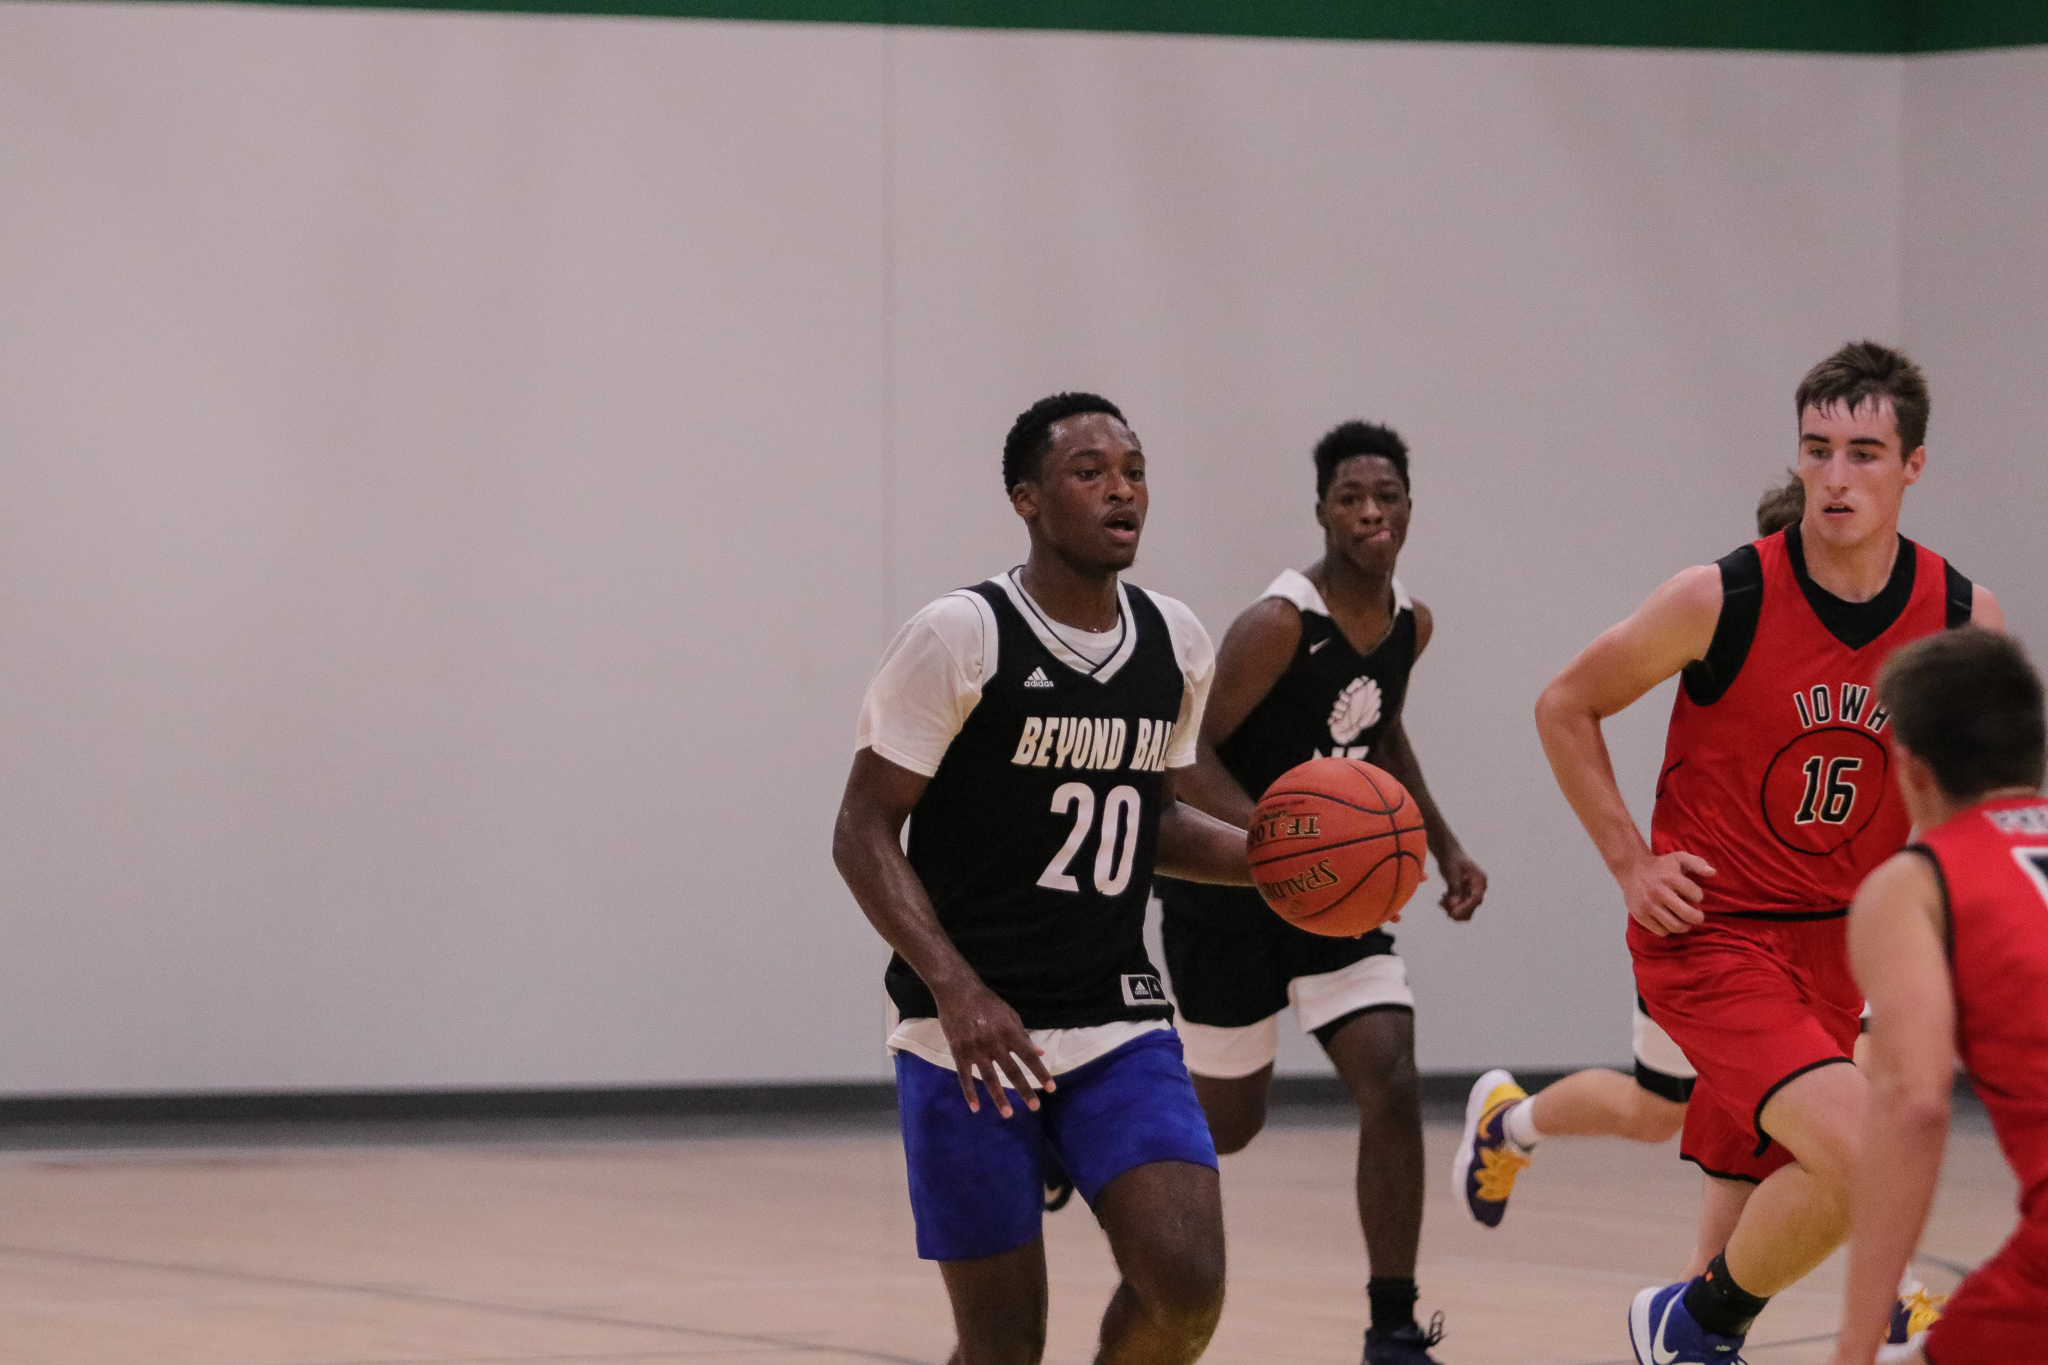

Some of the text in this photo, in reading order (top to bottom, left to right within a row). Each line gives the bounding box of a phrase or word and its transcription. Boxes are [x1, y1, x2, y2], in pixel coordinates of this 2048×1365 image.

[1024, 678, 1054, 688] adidas
[1793, 682, 1891, 734] IOWA
[1011, 716, 1127, 770] BEYOND
[1794, 755, 1863, 825] 16
[1036, 782, 1141, 896] 20
